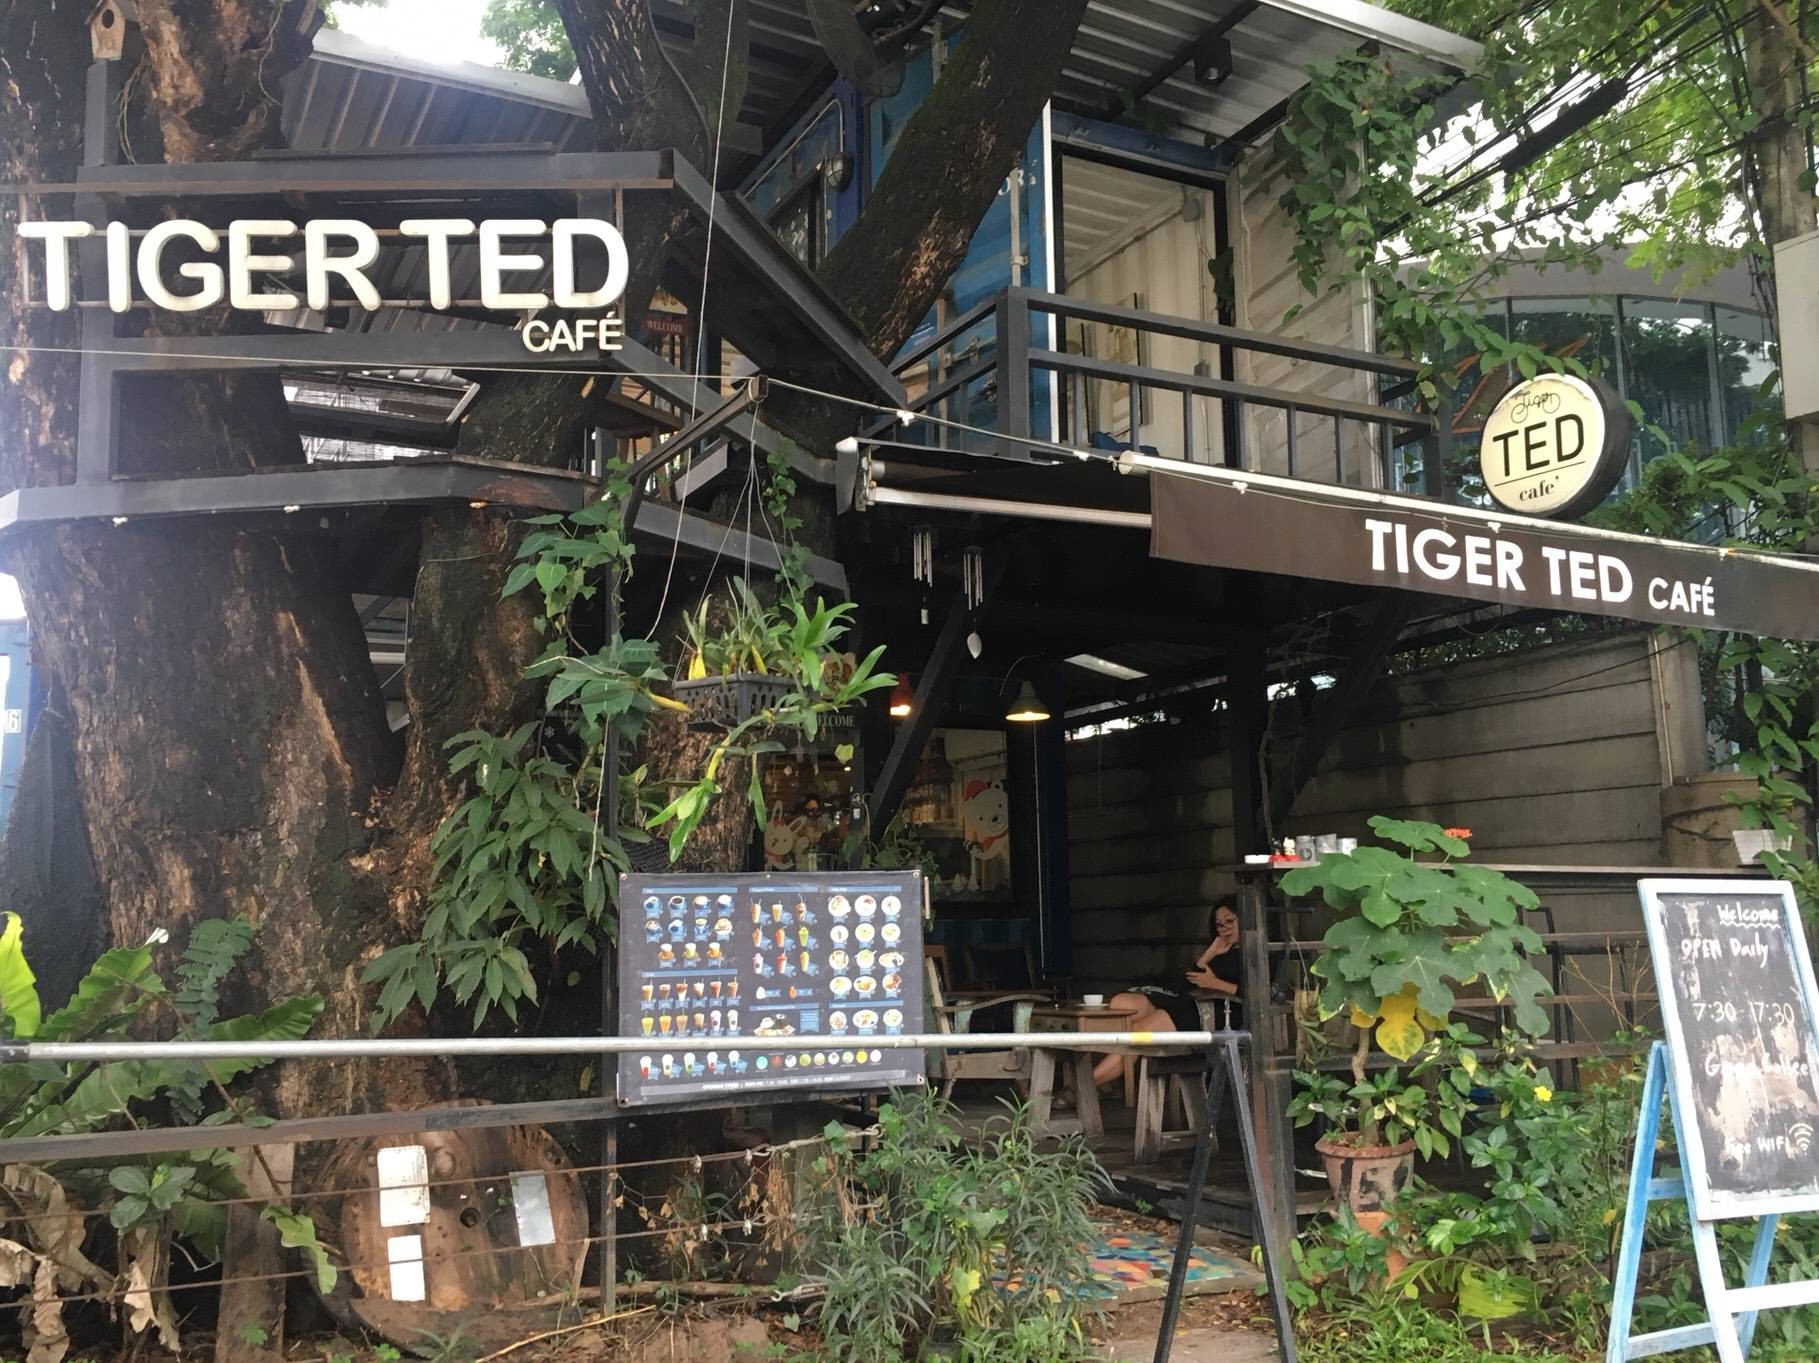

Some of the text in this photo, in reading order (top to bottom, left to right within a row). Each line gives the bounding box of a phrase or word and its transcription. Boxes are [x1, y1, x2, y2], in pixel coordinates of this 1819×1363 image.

[17, 218, 629, 312] TIGER TED
[522, 311, 623, 352] CAFÉ
[647, 319, 683, 333] WELCOME
[1492, 413, 1585, 478] TED
[1365, 519, 1716, 617] TIGER TED CAFÉ
[814, 714, 856, 728] ELCOME
[1716, 901, 1779, 922] Welcome
[1681, 931, 1768, 968] OPEN Daily
